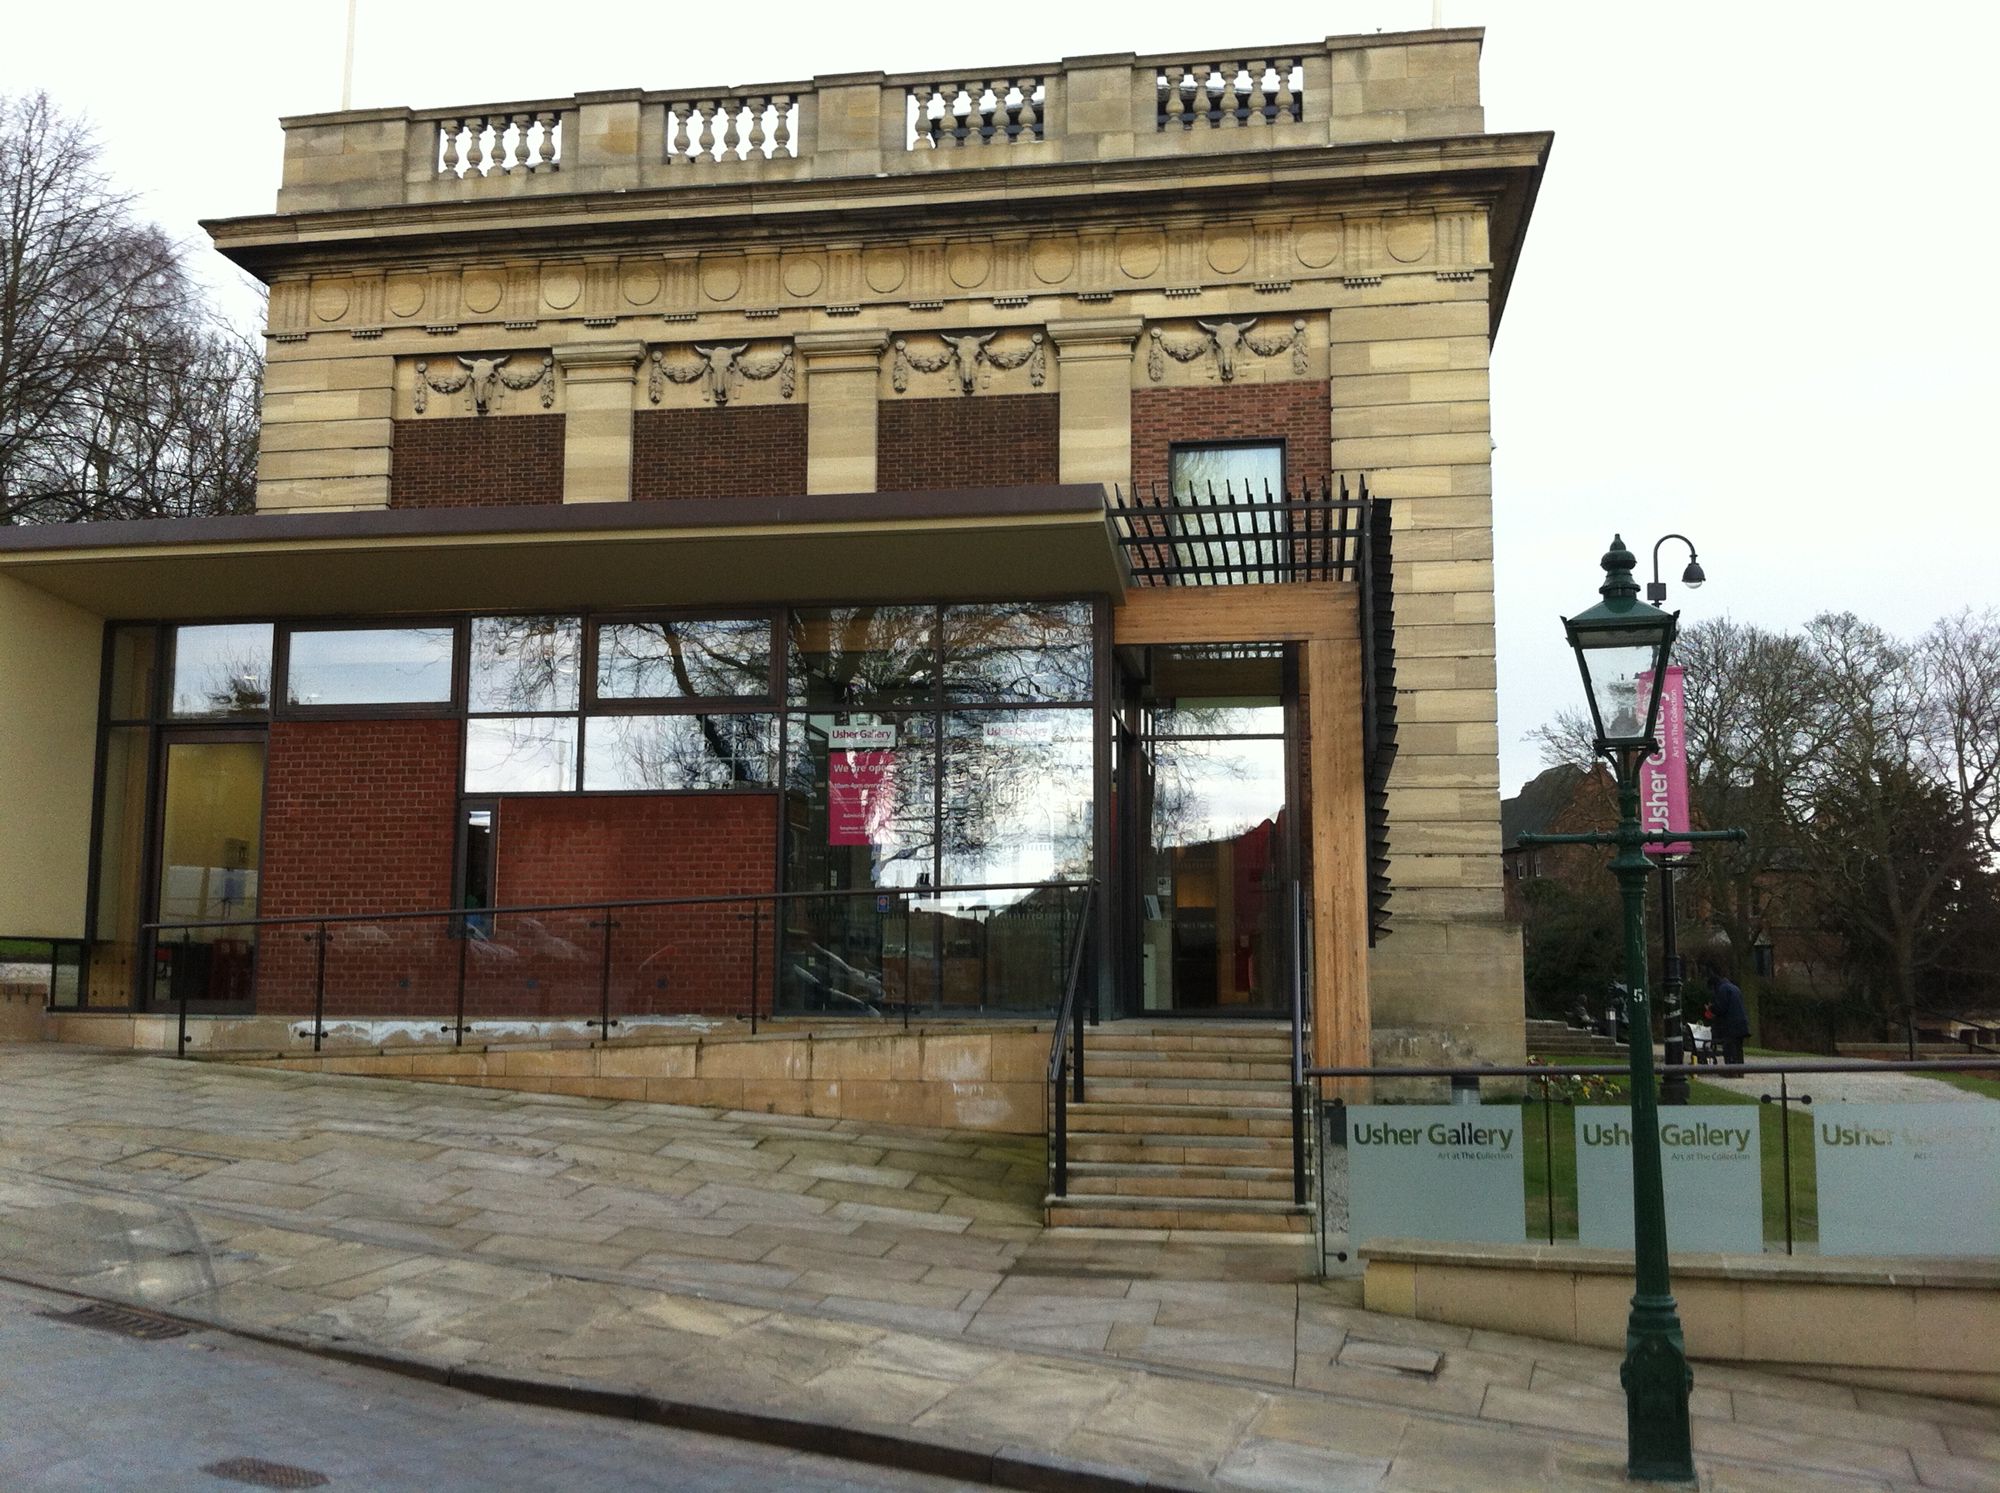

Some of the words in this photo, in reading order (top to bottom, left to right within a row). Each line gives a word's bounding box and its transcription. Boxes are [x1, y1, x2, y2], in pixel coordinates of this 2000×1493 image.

[832, 729, 857, 739] Usher
[1645, 691, 1668, 766] Galle
[834, 764, 849, 773] We
[1645, 769, 1670, 834] Usher
[1633, 988, 1643, 1003] 5
[1354, 1122, 1423, 1146] Usher
[1427, 1122, 1514, 1151] Gallery
[1583, 1122, 1633, 1147] Ush
[1660, 1122, 1751, 1152] Gallery
[1461, 1151, 1475, 1160] The
[1476, 1151, 1513, 1160] Collection
